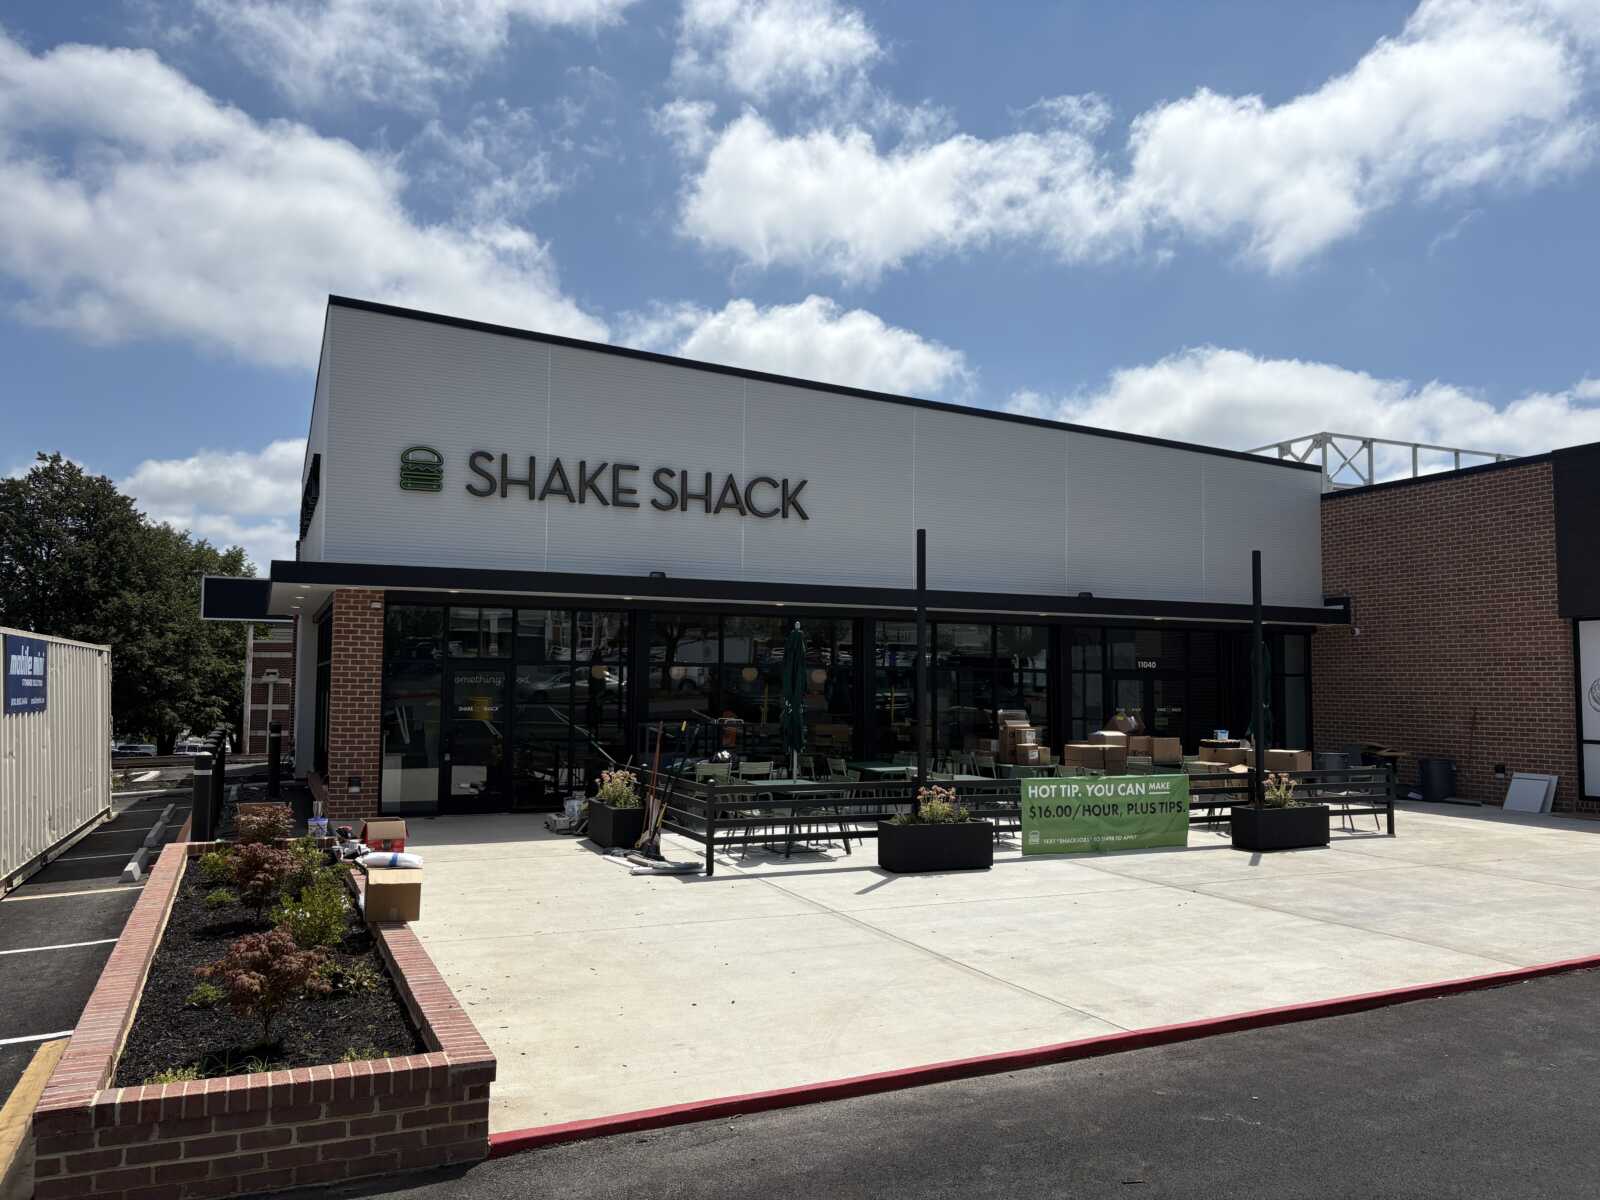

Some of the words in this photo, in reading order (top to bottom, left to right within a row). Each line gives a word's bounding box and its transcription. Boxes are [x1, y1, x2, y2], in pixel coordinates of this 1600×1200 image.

[465, 450, 640, 508] SHAKE
[650, 467, 810, 520] SHACK
[1137, 661, 1157, 669] 11040
[1028, 784, 1057, 798] HOT
[1059, 784, 1082, 797] TIP.
[1086, 783, 1115, 797] YOU
[1117, 782, 1145, 796] CAN
[1149, 782, 1170, 790] MAKE
[1029, 803, 1123, 820] $16.00/HOUR,
[1127, 801, 1156, 815] PLUS
[1159, 800, 1186, 813] TIPS.
